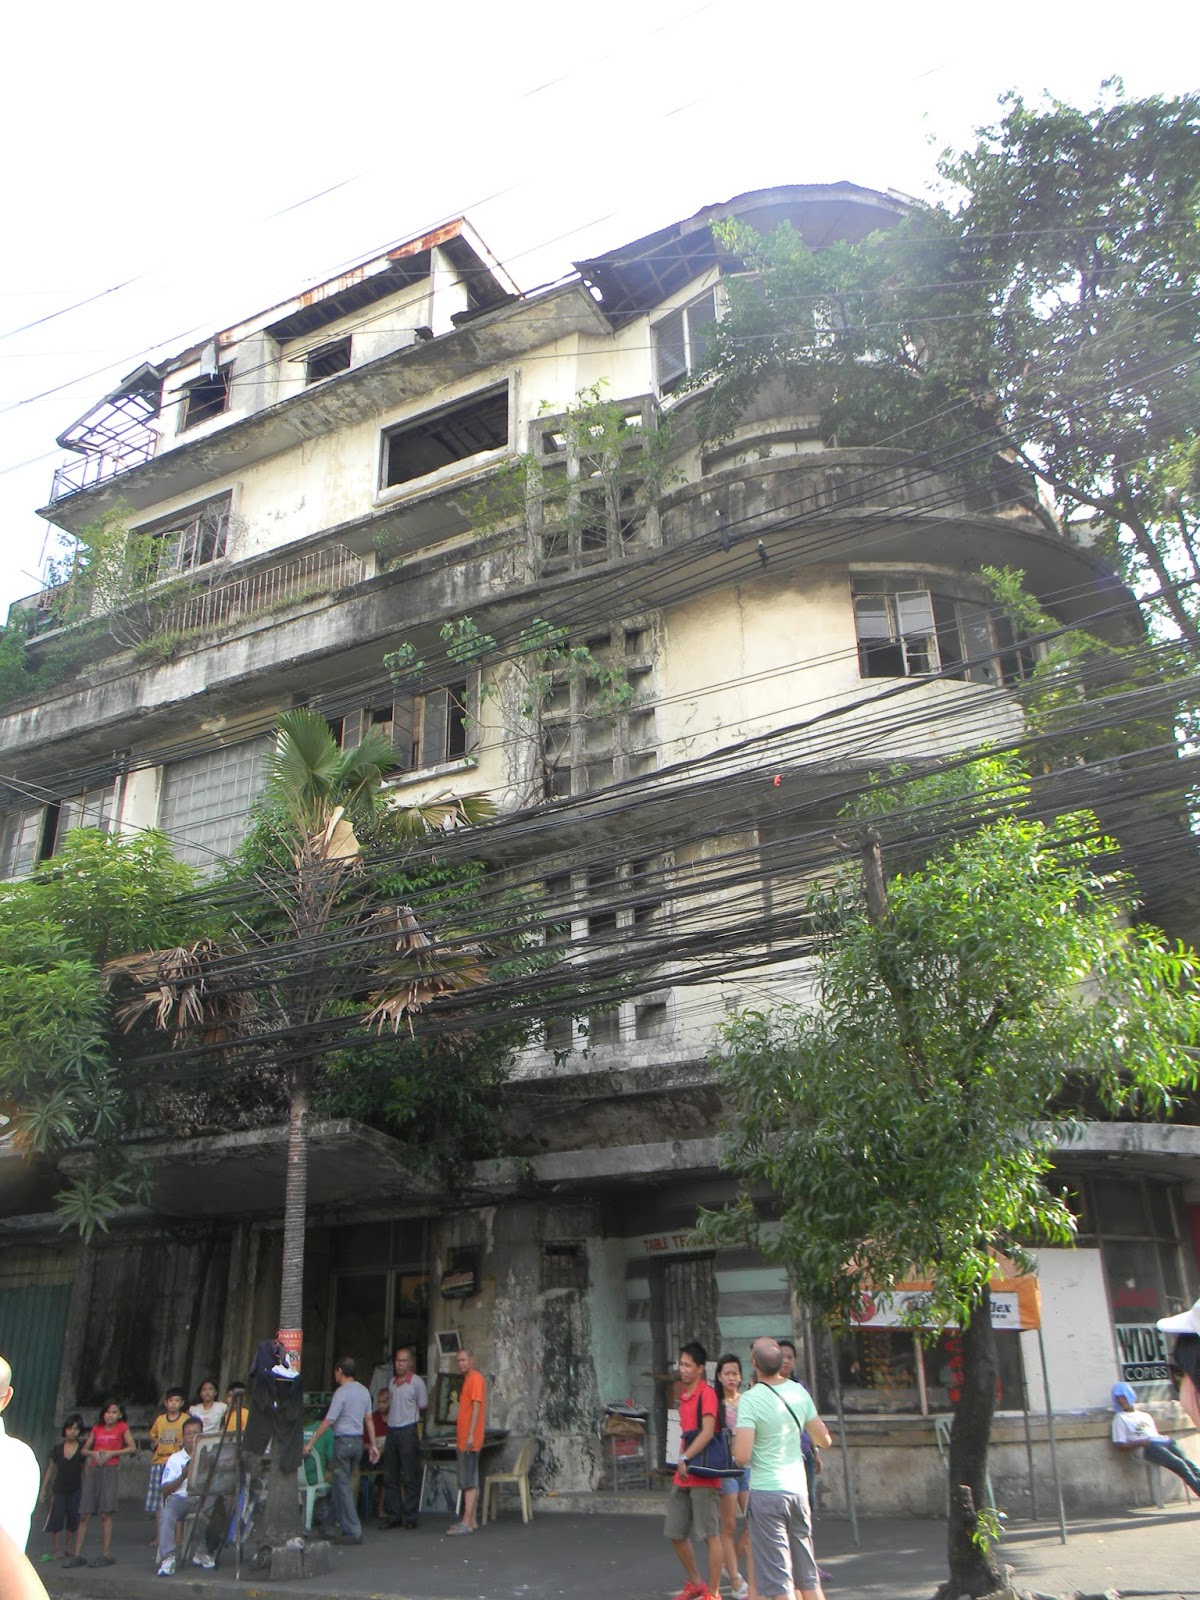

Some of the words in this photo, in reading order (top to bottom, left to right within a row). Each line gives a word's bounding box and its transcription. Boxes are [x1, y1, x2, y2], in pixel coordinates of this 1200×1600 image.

[643, 1237, 669, 1252] TABLE
[1116, 1327, 1166, 1362] WIDE
[1124, 1365, 1168, 1381] COPIES
